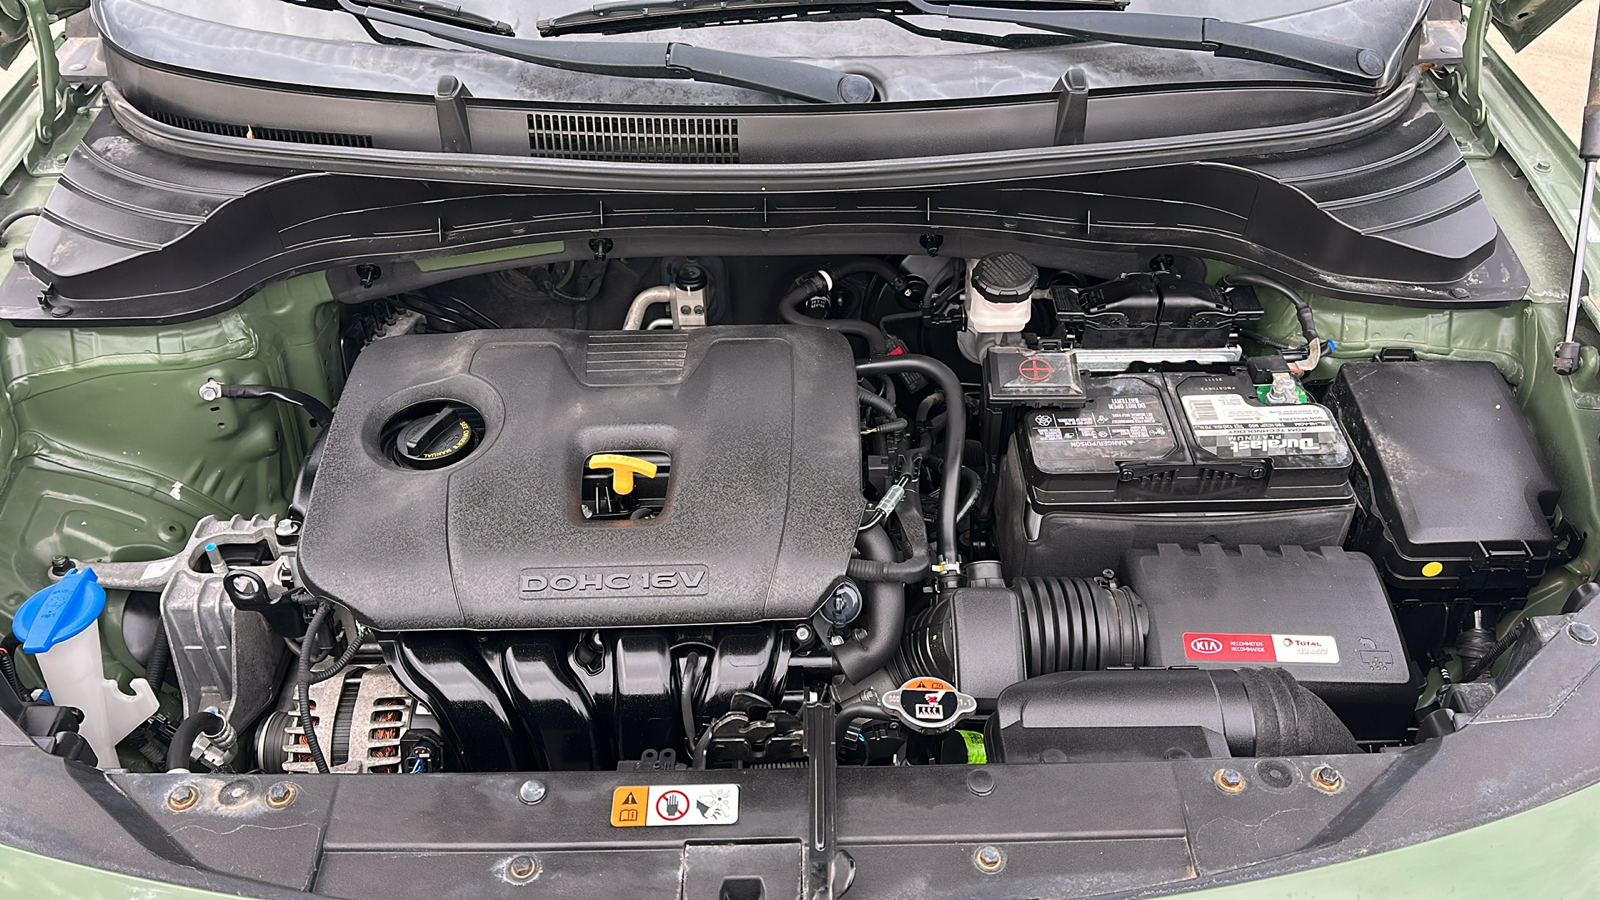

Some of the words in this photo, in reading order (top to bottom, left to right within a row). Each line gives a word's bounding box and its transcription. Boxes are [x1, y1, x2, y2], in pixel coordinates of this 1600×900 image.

[459, 421, 469, 430] SEE
[1229, 437, 1321, 453] Duralast
[423, 448, 452, 458] MANUAL
[522, 573, 632, 592] DOHC
[642, 570, 706, 590] 16V
[1195, 639, 1219, 651] KIA
